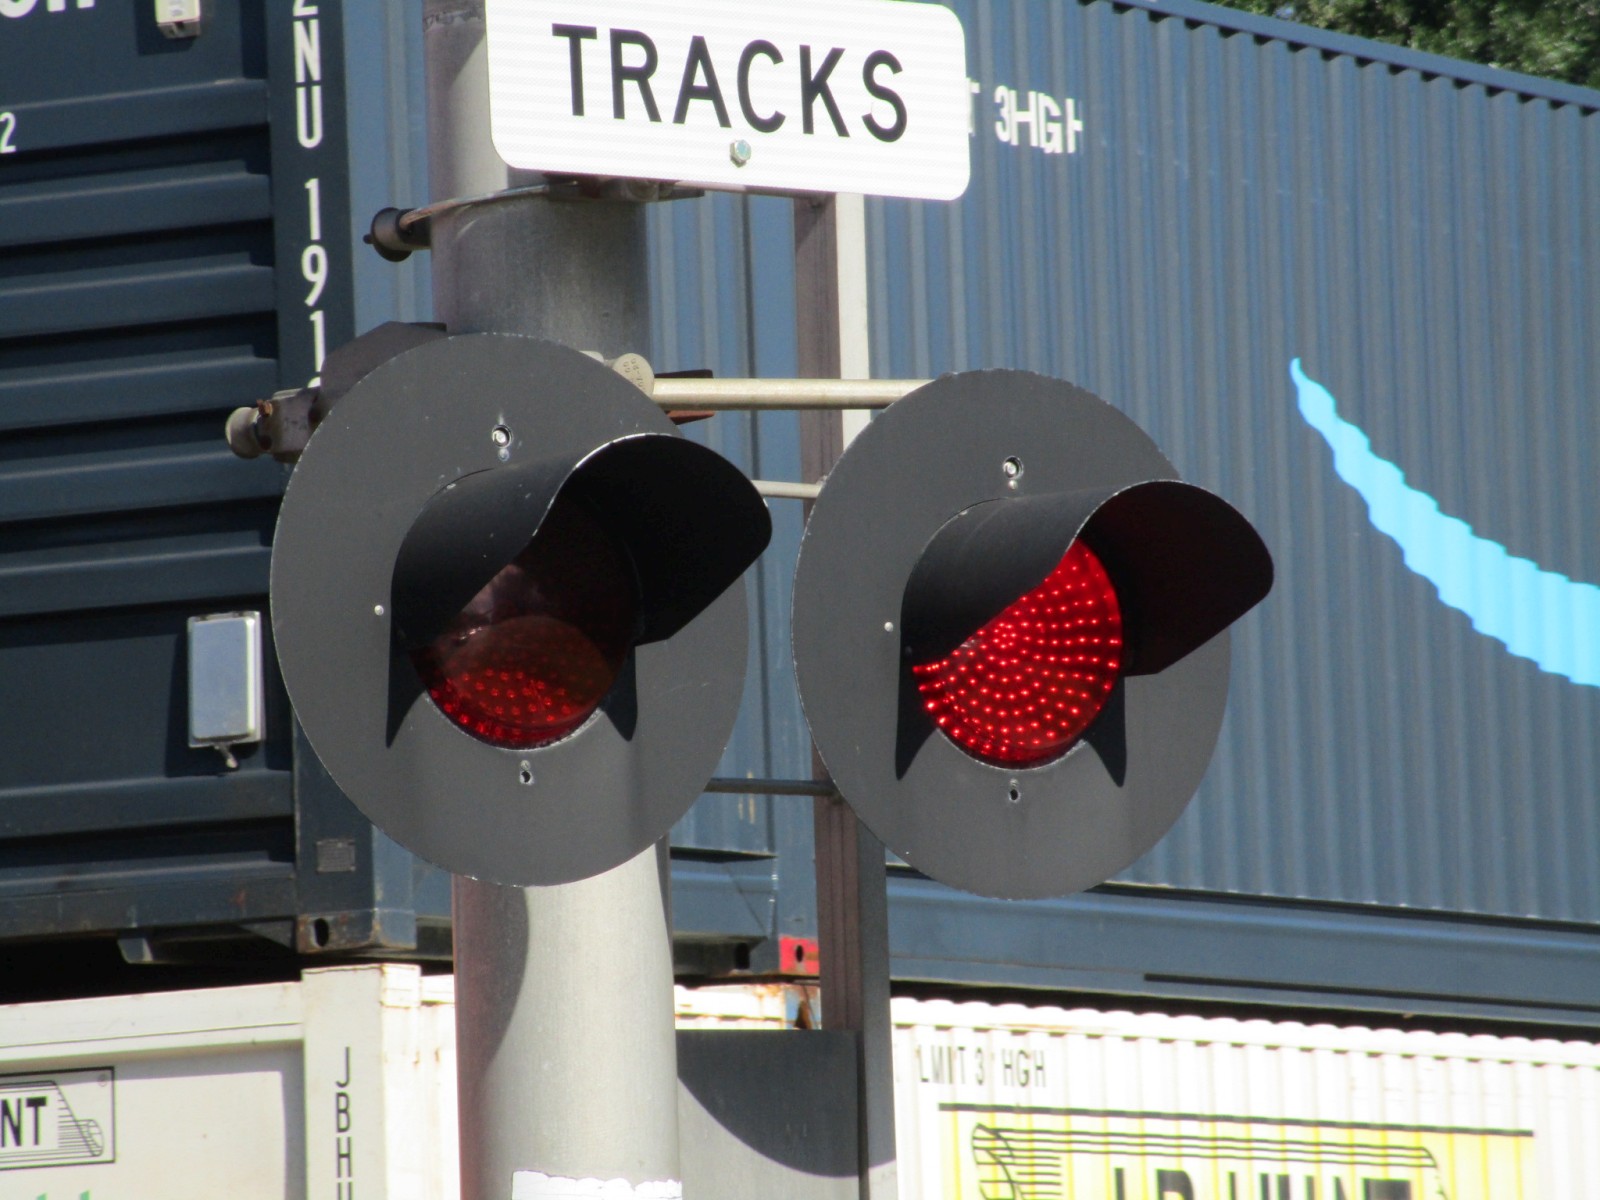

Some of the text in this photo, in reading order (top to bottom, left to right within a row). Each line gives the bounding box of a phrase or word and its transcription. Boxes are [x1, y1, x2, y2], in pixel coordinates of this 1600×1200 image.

[292, 0, 328, 388] NU 191
[551, 22, 908, 143] TRACKS
